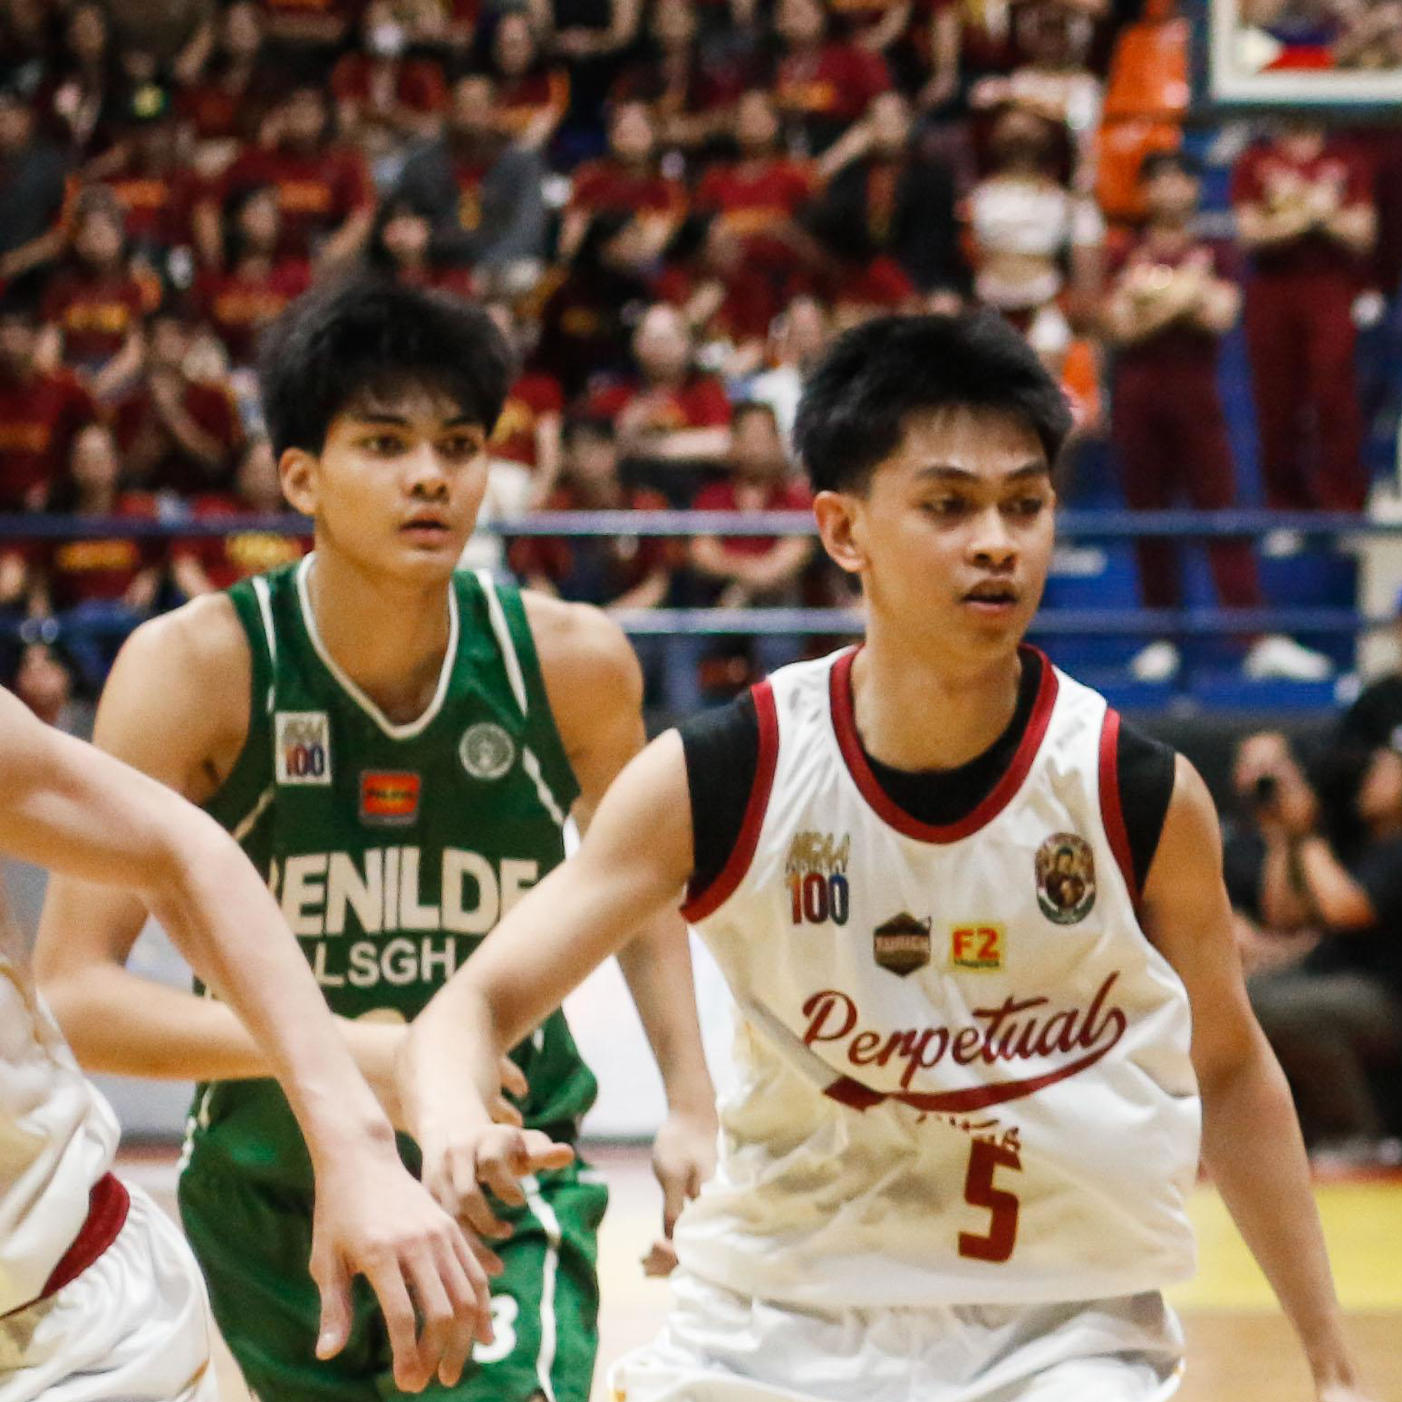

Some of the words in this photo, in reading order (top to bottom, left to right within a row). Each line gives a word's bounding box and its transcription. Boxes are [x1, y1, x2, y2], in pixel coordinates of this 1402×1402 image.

[268, 846, 540, 936] ENILDE
[785, 873, 849, 926] 100
[313, 938, 457, 987] LSGH
[953, 927, 1000, 960] F2
[802, 971, 1127, 1090] Perpetual
[957, 1137, 1023, 1264] 5
